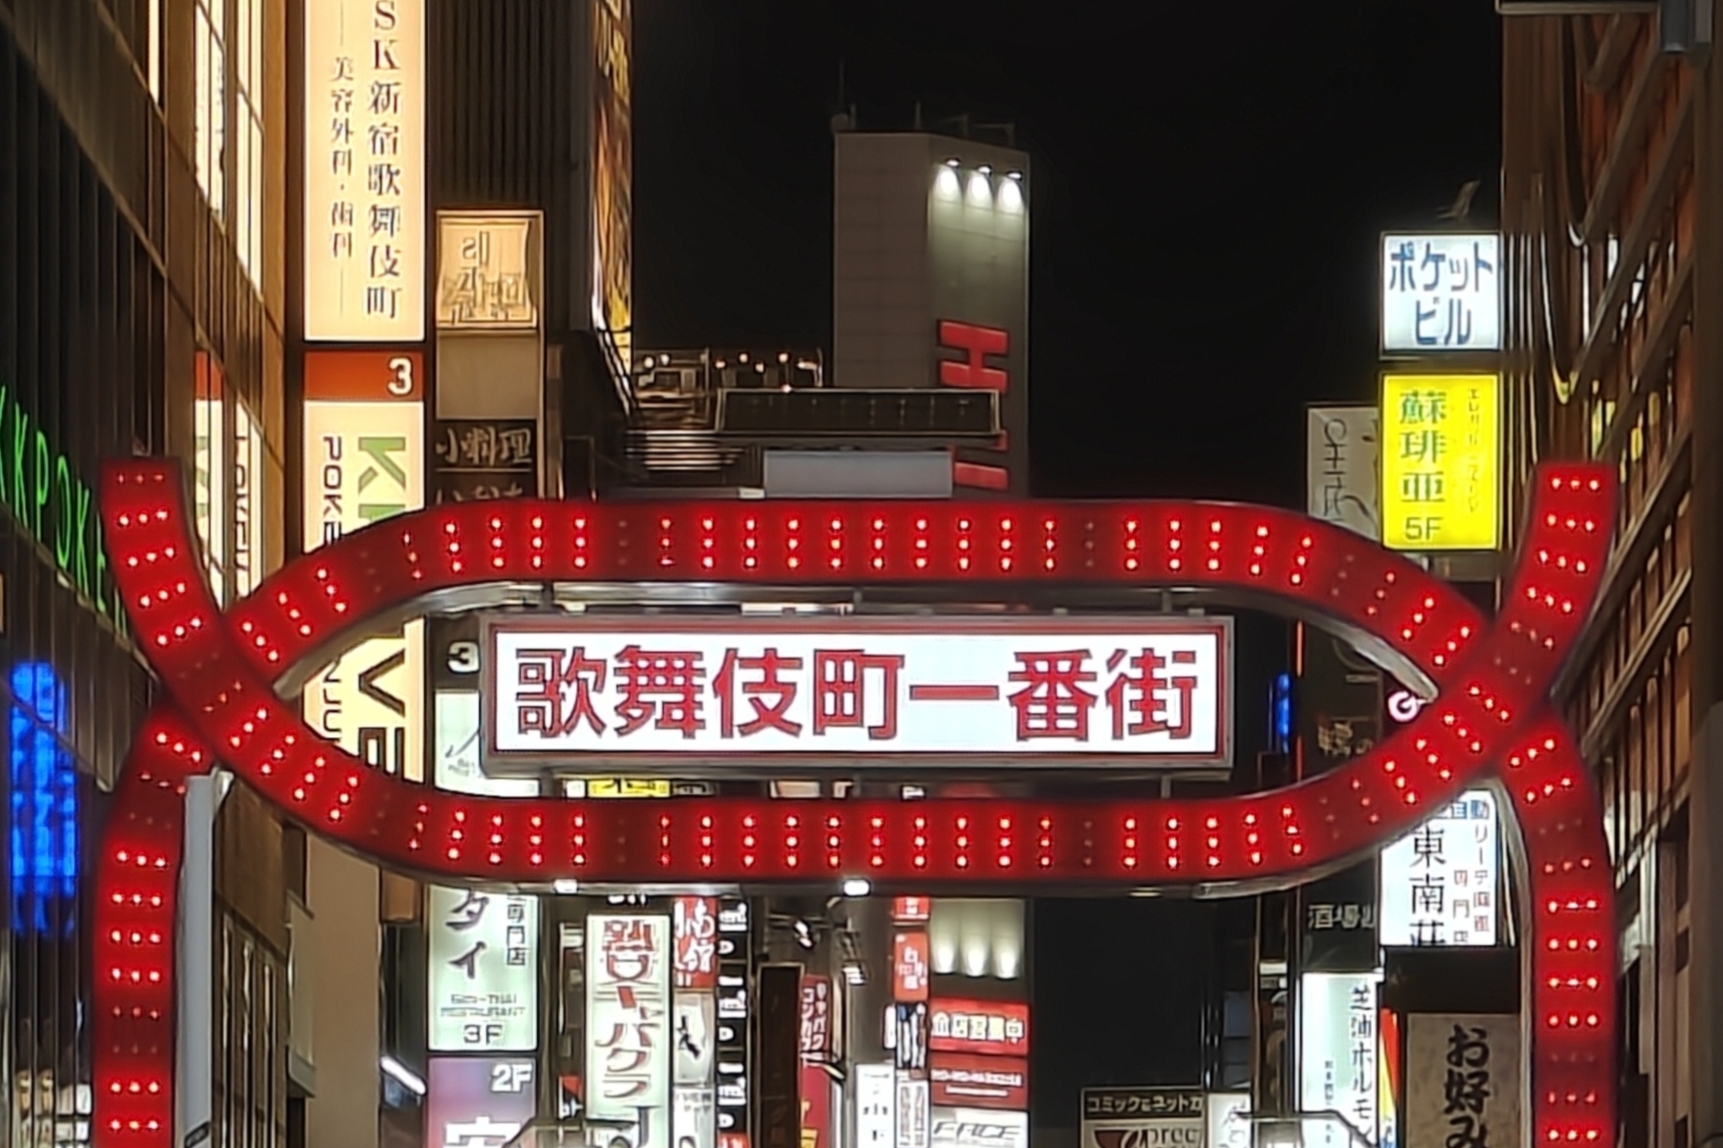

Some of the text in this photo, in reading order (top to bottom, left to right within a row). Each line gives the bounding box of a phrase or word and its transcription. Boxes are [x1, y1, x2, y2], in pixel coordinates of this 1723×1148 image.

[1389, 241, 1494, 293] ポケット
[1414, 297, 1472, 346] ビル
[388, 357, 413, 395] 3
[323, 436, 343, 542] POKE
[1405, 517, 1444, 541] 5F
[515, 644, 1200, 743] 歌舞伎町一番街
[463, 1023, 504, 1045] 3F
[490, 1064, 532, 1093] 2F
